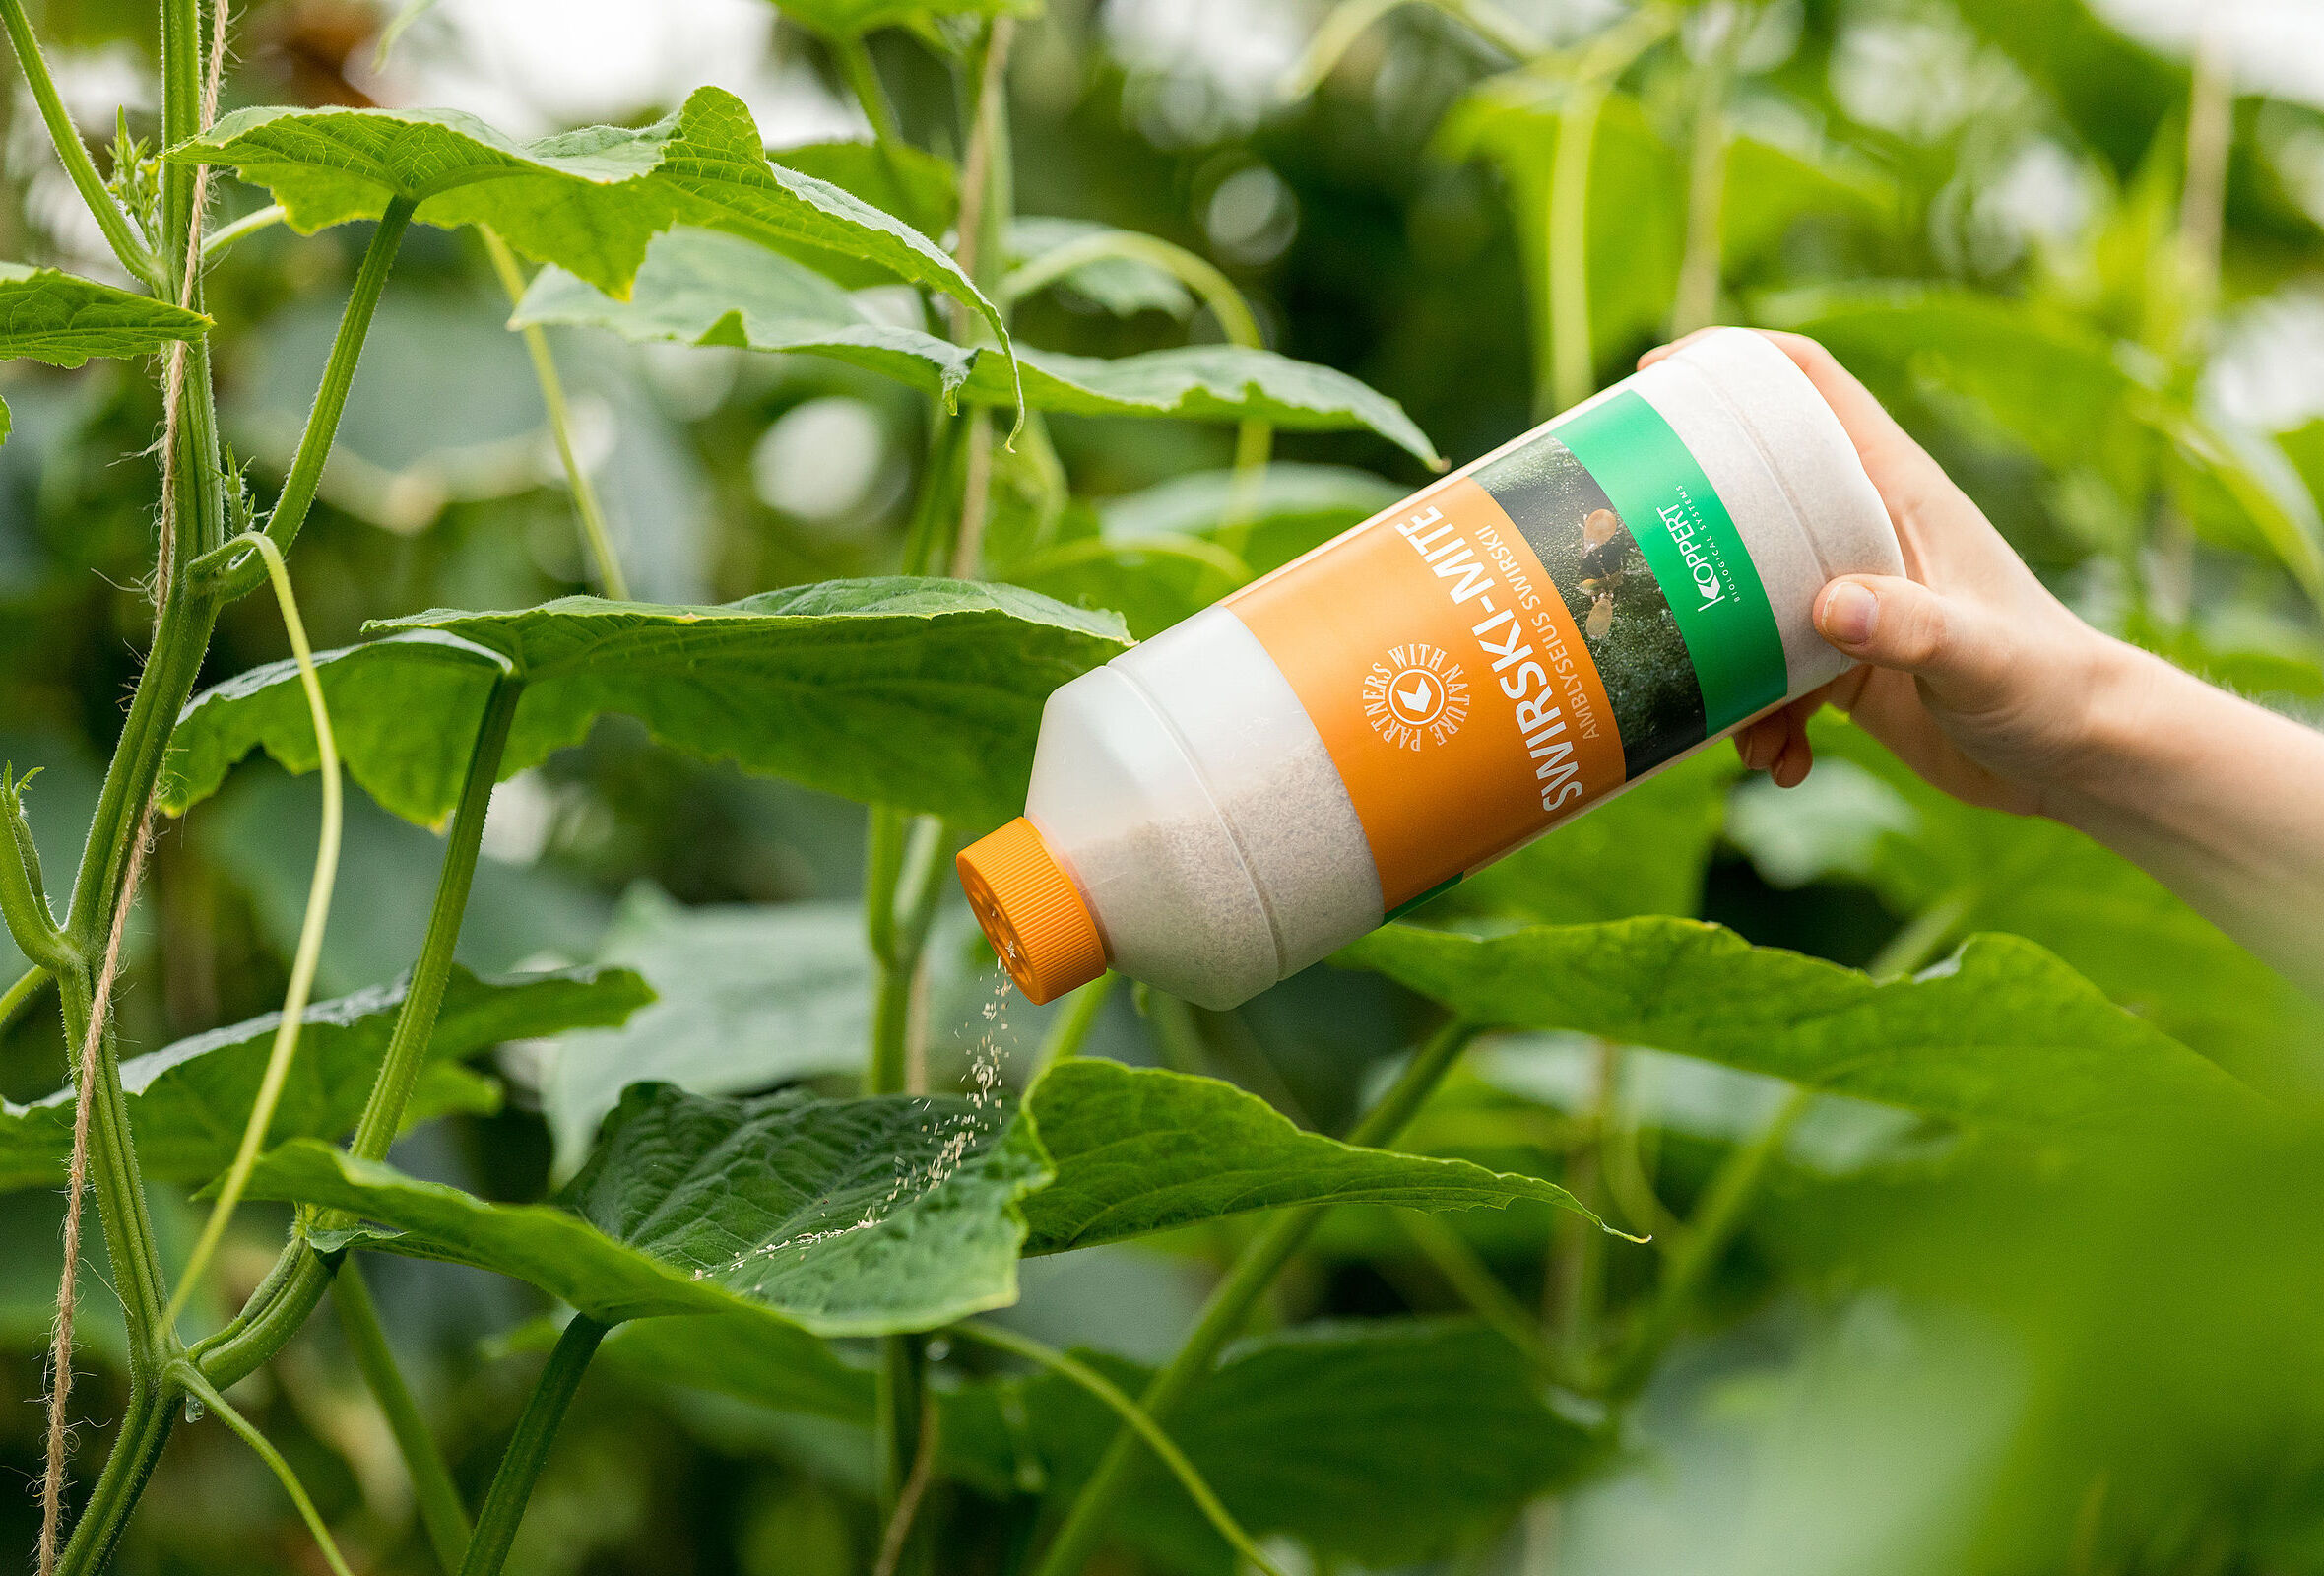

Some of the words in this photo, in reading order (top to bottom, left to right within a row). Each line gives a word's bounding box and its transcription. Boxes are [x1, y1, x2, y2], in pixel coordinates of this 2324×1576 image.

[1676, 486, 1707, 531] SYSTEMS
[1474, 524, 1541, 611] SWIRSKII
[1656, 504, 1725, 612] KOPPERT
[1707, 536, 1740, 602] BIOLOGICAL
[1388, 643, 1448, 670] WITH
[1394, 505, 1583, 812] SWIRSKI-MITE
[1531, 612, 1600, 740] AMBLYSEIUS
[1362, 662, 1422, 752] PARTNERS
[1437, 663, 1470, 747] NATURE
